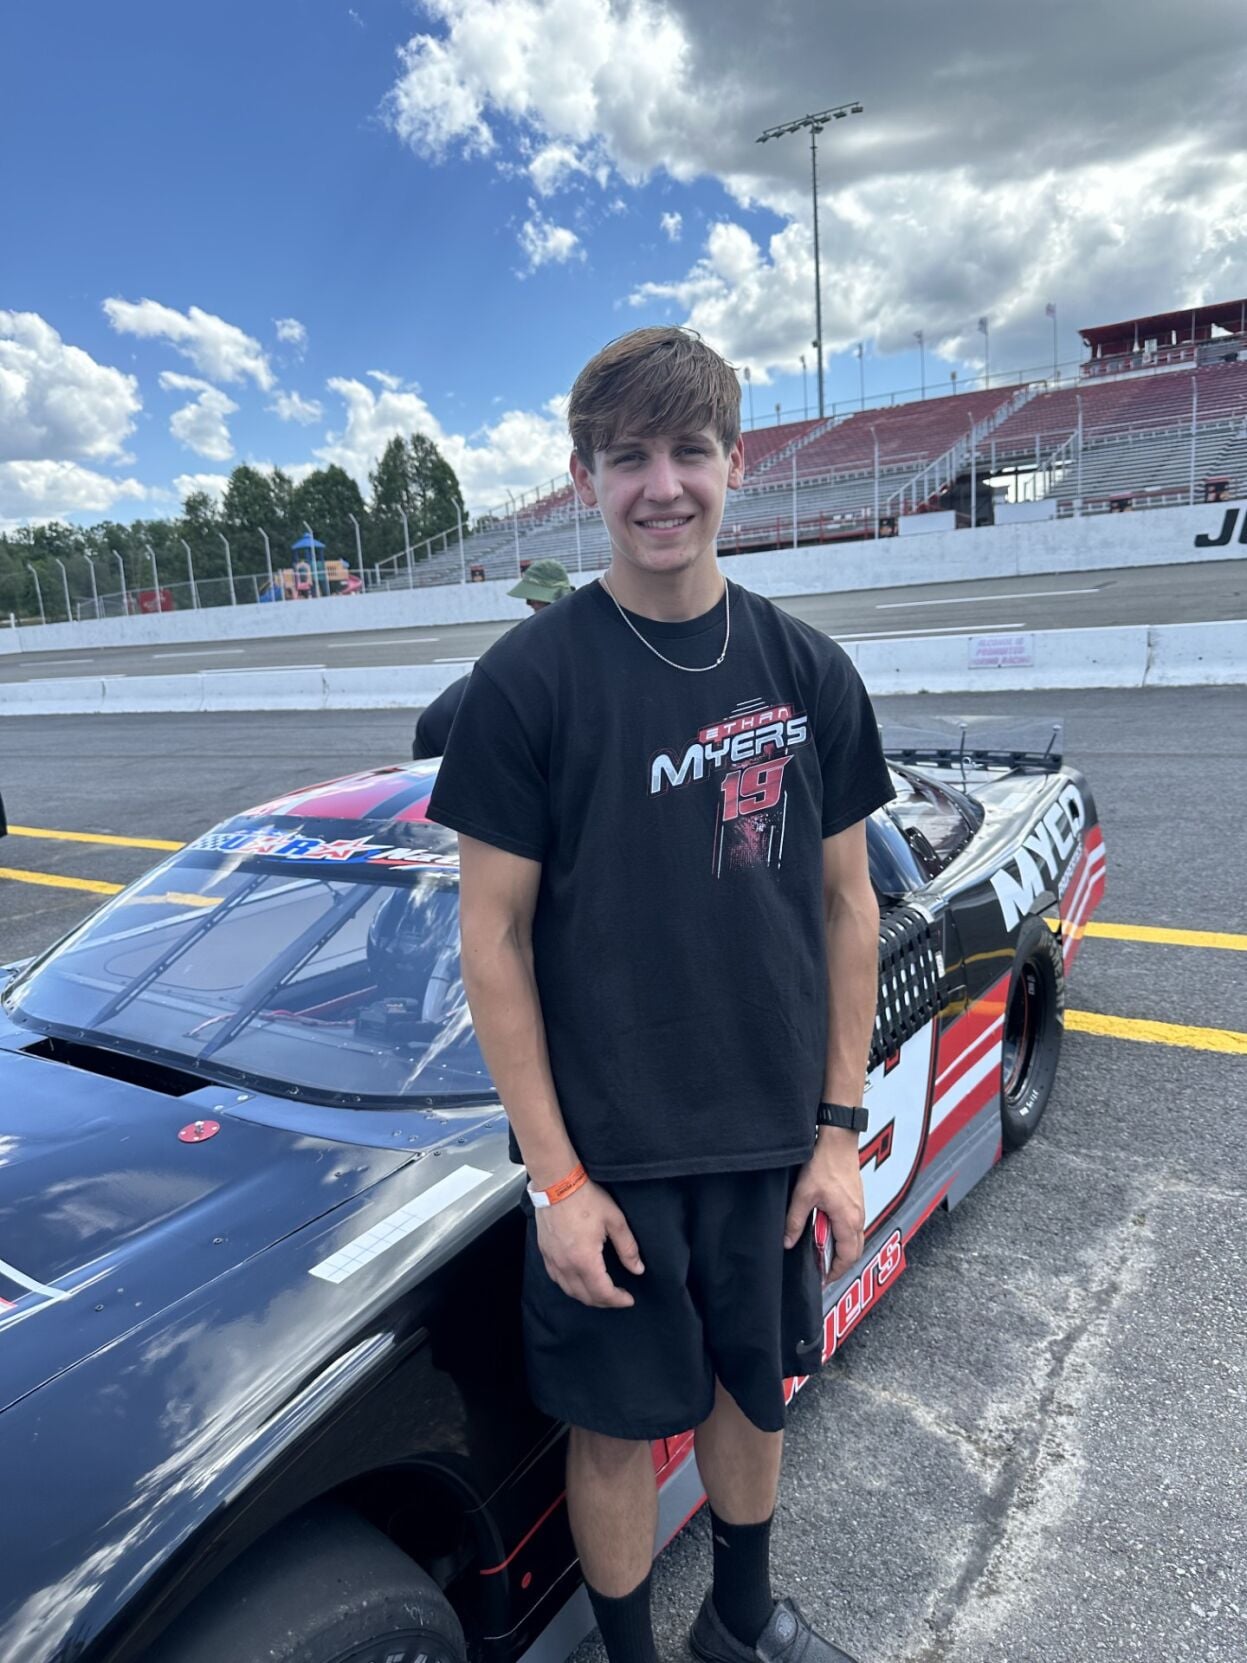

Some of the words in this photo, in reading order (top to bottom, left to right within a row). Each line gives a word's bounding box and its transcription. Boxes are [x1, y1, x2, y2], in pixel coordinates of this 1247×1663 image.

[1194, 507, 1247, 549] J
[650, 715, 808, 785] MYERS
[706, 707, 789, 740] ETHAN
[720, 754, 795, 823] 19
